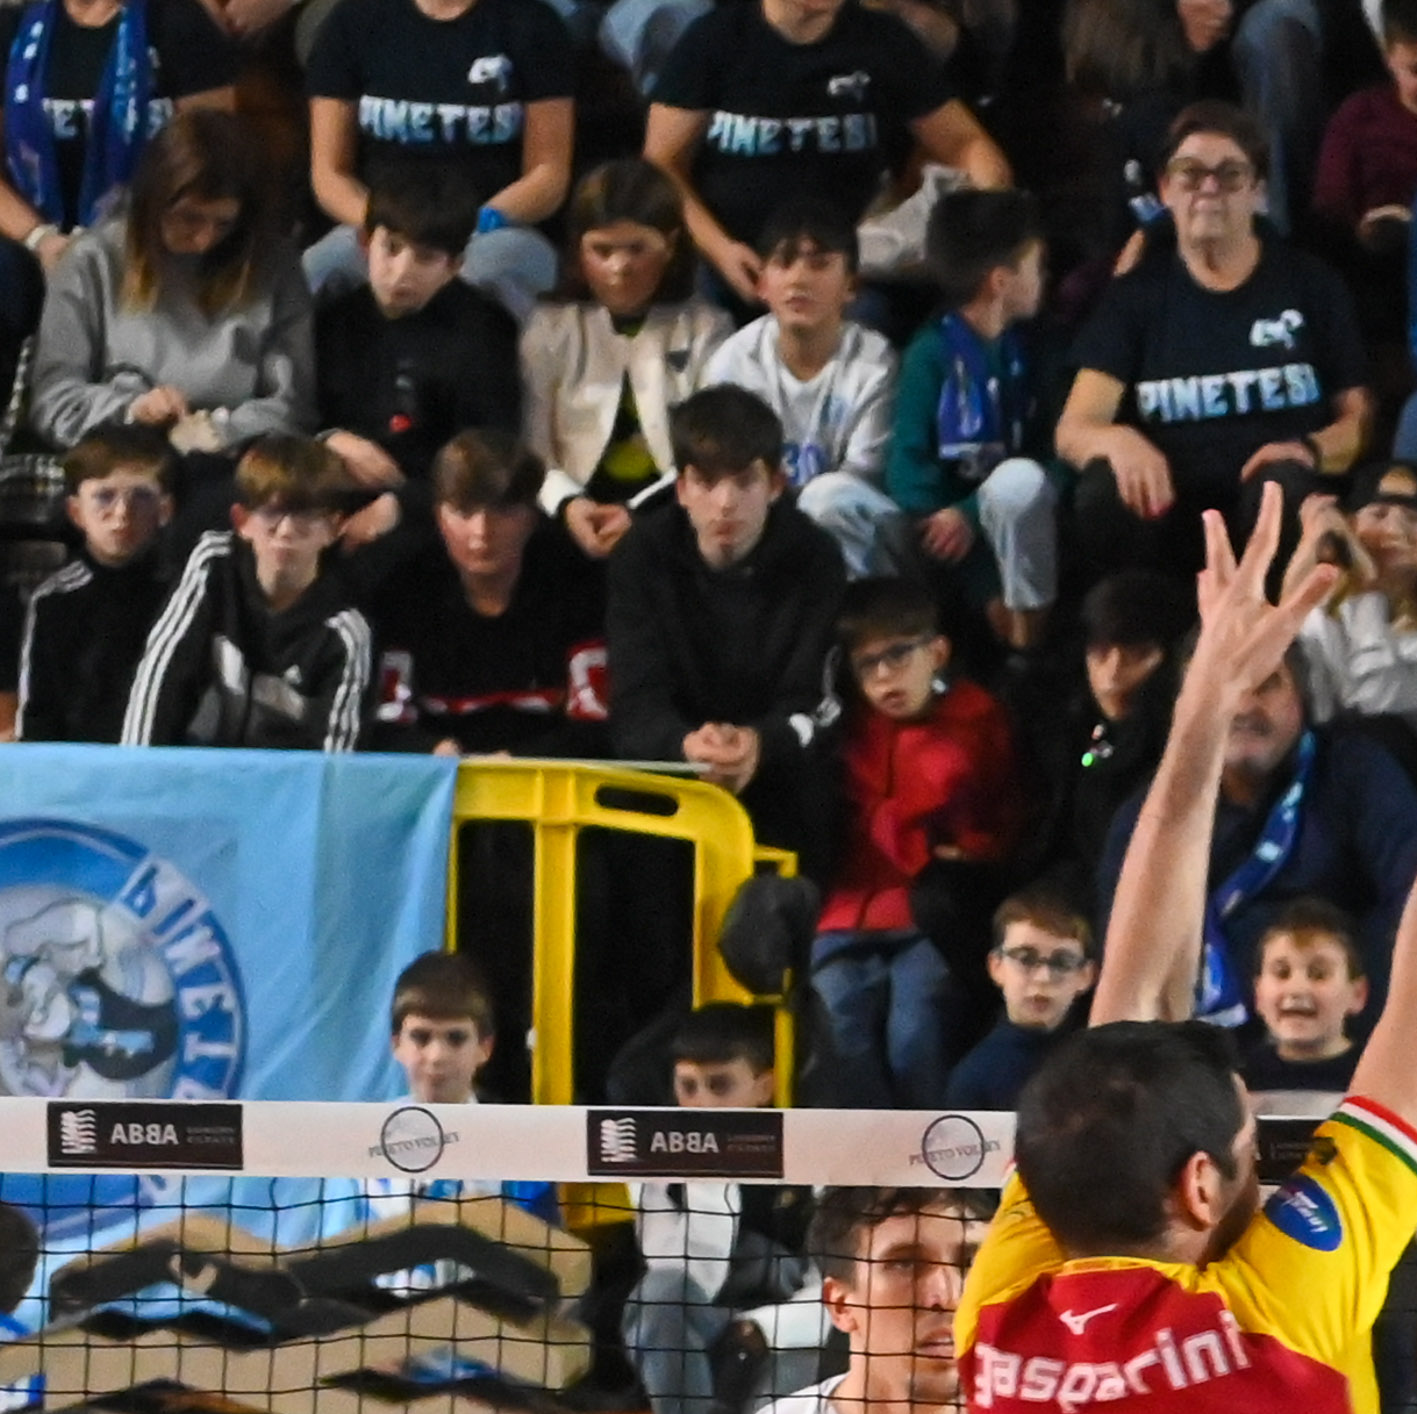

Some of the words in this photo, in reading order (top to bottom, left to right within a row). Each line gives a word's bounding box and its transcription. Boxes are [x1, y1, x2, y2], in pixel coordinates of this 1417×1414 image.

[111, 1123, 179, 1146] ABBA
[651, 1131, 719, 1154] ABBA
[973, 1308, 1252, 1414] gasparini
